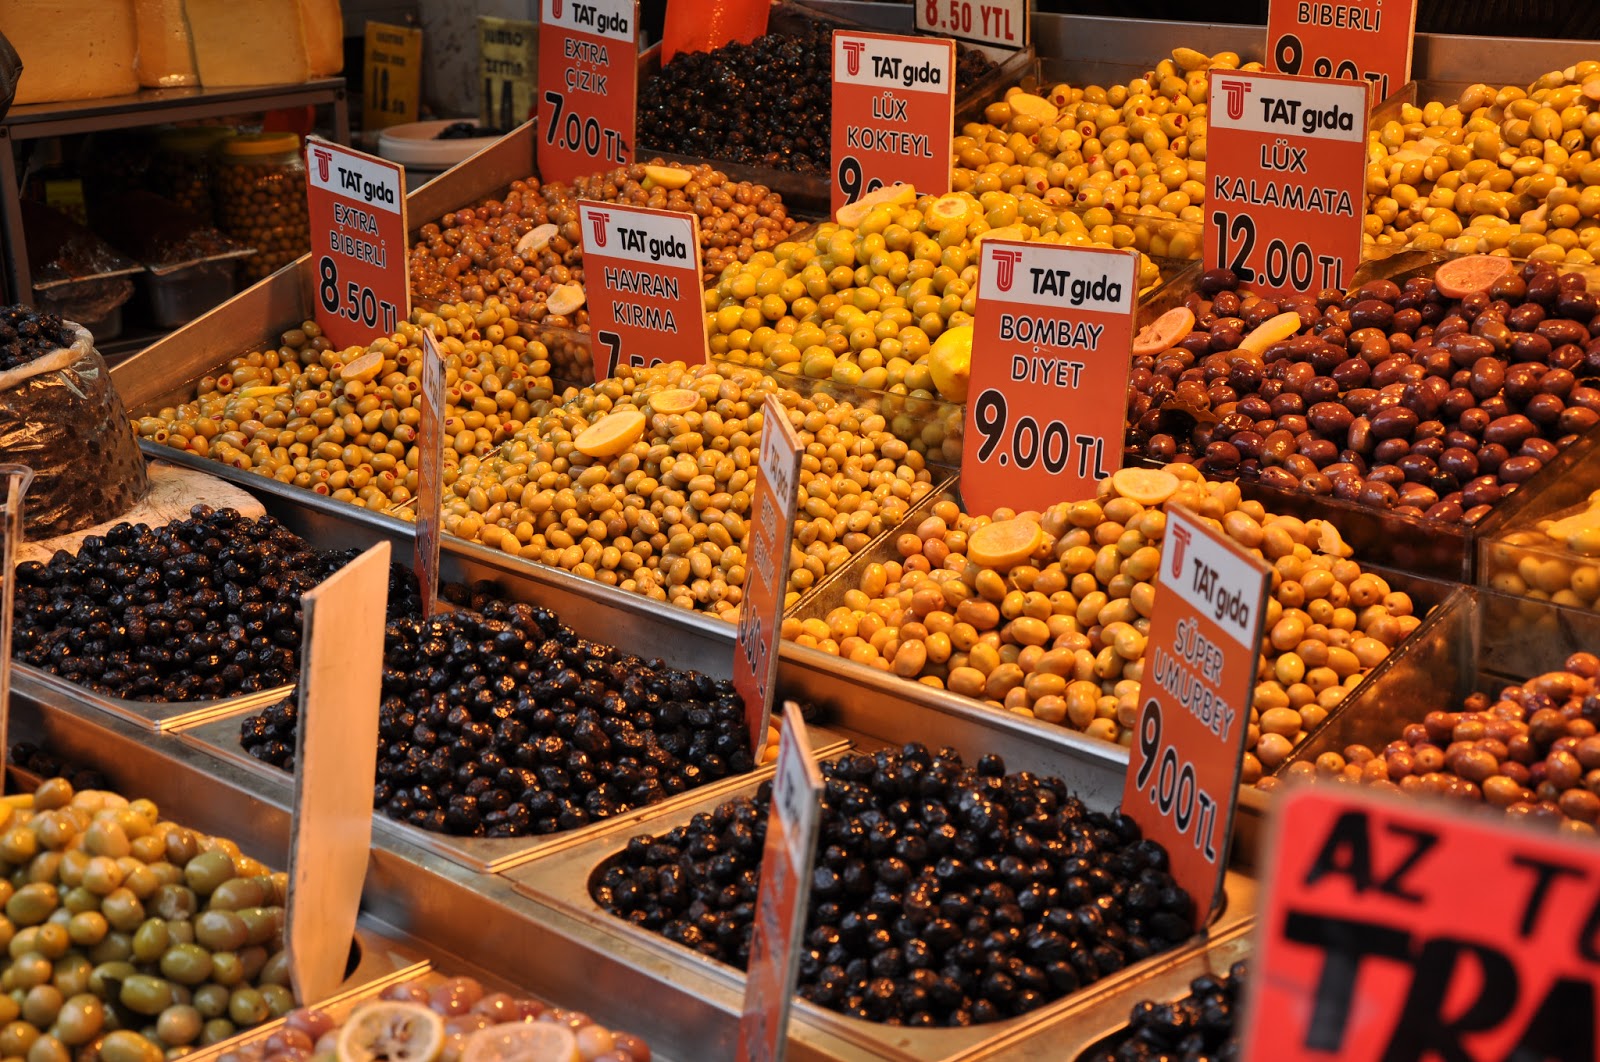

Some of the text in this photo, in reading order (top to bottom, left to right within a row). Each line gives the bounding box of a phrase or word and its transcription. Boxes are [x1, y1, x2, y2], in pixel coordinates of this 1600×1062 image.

[572, 3, 597, 26] TAT
[926, 0, 1014, 40] 8.50 YTL
[564, 38, 609, 66] EXTRA
[872, 56, 902, 79] TAT
[565, 61, 607, 96] ÇİZİK
[872, 92, 907, 121] LÜX
[1260, 97, 1301, 126] TAT
[545, 91, 600, 157] 7.00
[604, 128, 626, 164] TL
[847, 126, 933, 158] KOKTEYL
[1260, 138, 1308, 174] LÜX
[338, 167, 362, 193] TAT
[1214, 175, 1354, 217] KALAMATA
[334, 203, 379, 237] EXTRA
[330, 225, 386, 268] BİBERLİ
[617, 227, 647, 253] TAT
[1212, 211, 1347, 297] 12.00 TL
[320, 255, 377, 328] 8.50
[604, 266, 680, 301] HAVRAN
[1030, 267, 1070, 297] TAT
[613, 300, 677, 334] KIRMA
[999, 313, 1104, 351] BOMBAY
[1010, 346, 1085, 390] DİYET
[973, 387, 1111, 481] 9.00 TL
[1193, 557, 1219, 604] TAT
[1174, 616, 1224, 687] SÜPER
[1153, 647, 1235, 743] UMURBEY
[1136, 697, 1218, 864] 9.00 TL
[1304, 809, 1442, 905] AZ
